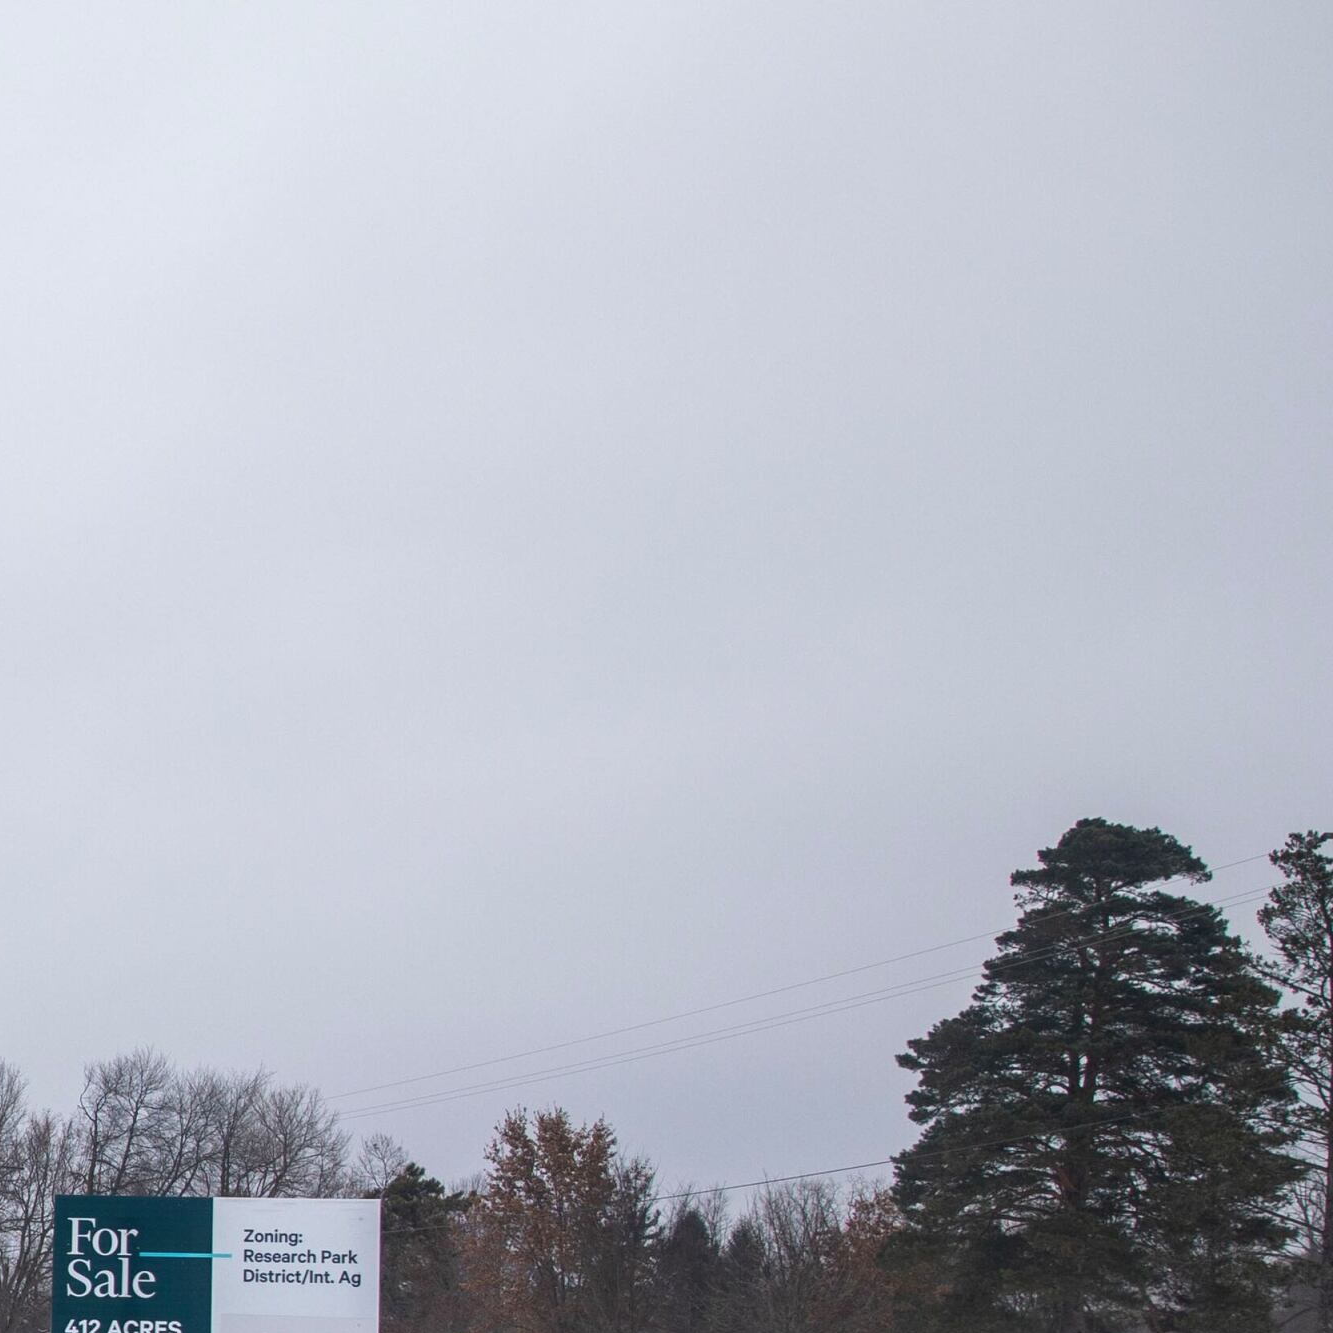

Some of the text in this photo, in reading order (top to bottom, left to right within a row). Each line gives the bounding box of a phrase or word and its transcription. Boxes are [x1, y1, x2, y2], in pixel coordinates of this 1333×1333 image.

[67, 1217, 138, 1256] For
[243, 1229, 303, 1246] Zoning:
[243, 1249, 358, 1264] Research Park
[66, 1258, 156, 1299] Sale
[243, 1270, 362, 1287] District/Int. Ag
